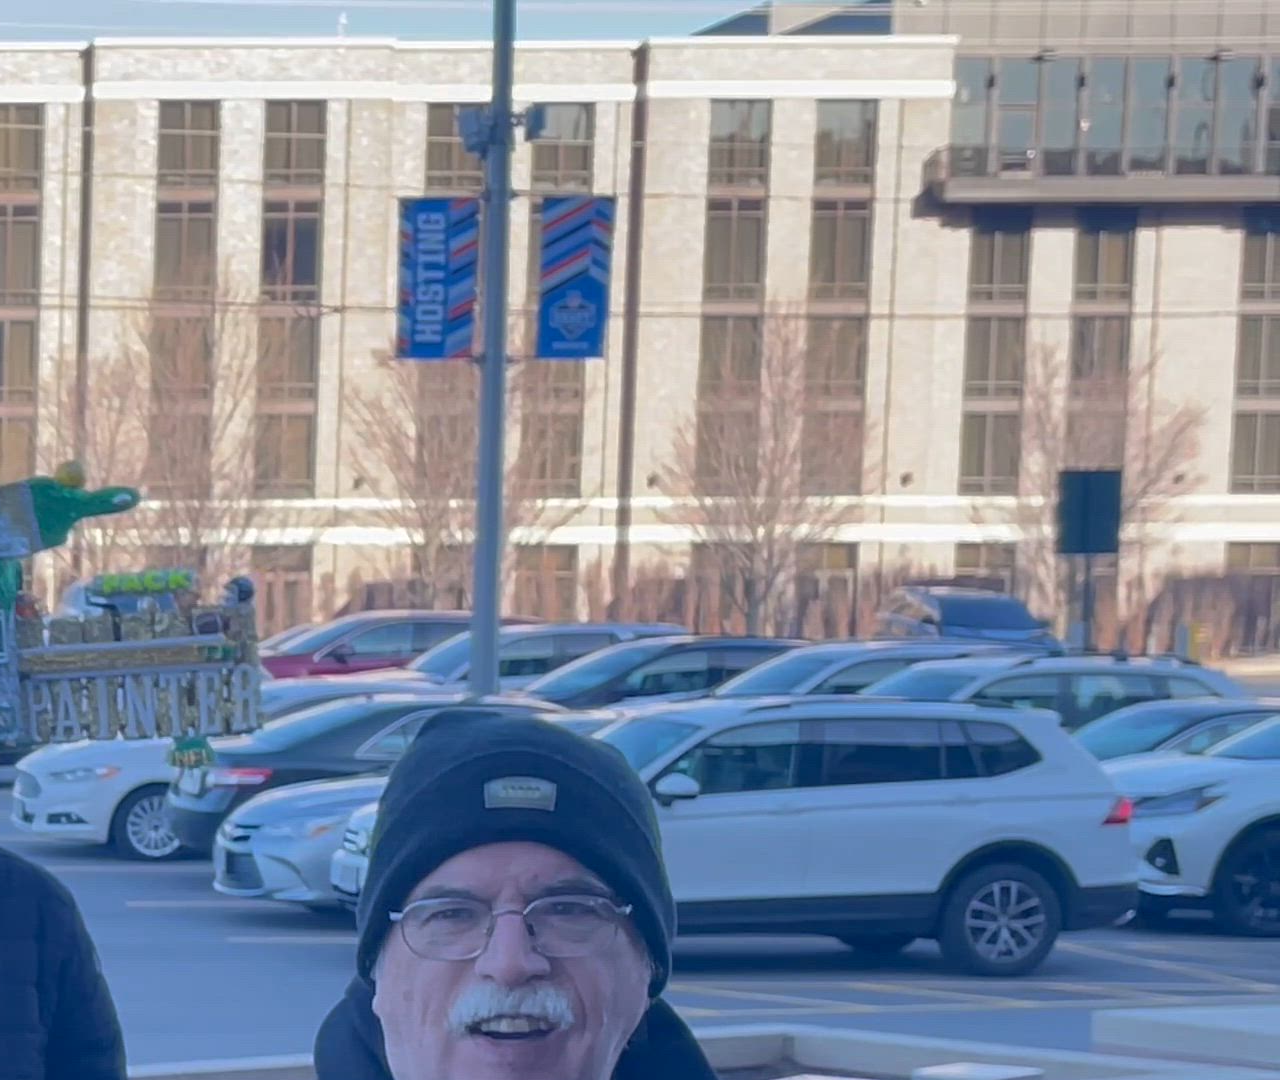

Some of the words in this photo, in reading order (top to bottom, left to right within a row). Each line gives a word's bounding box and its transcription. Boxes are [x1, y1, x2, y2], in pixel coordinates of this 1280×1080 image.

[413, 211, 446, 344] HOSTING
[103, 569, 191, 594] PACK
[27, 664, 261, 741] PAINTER
